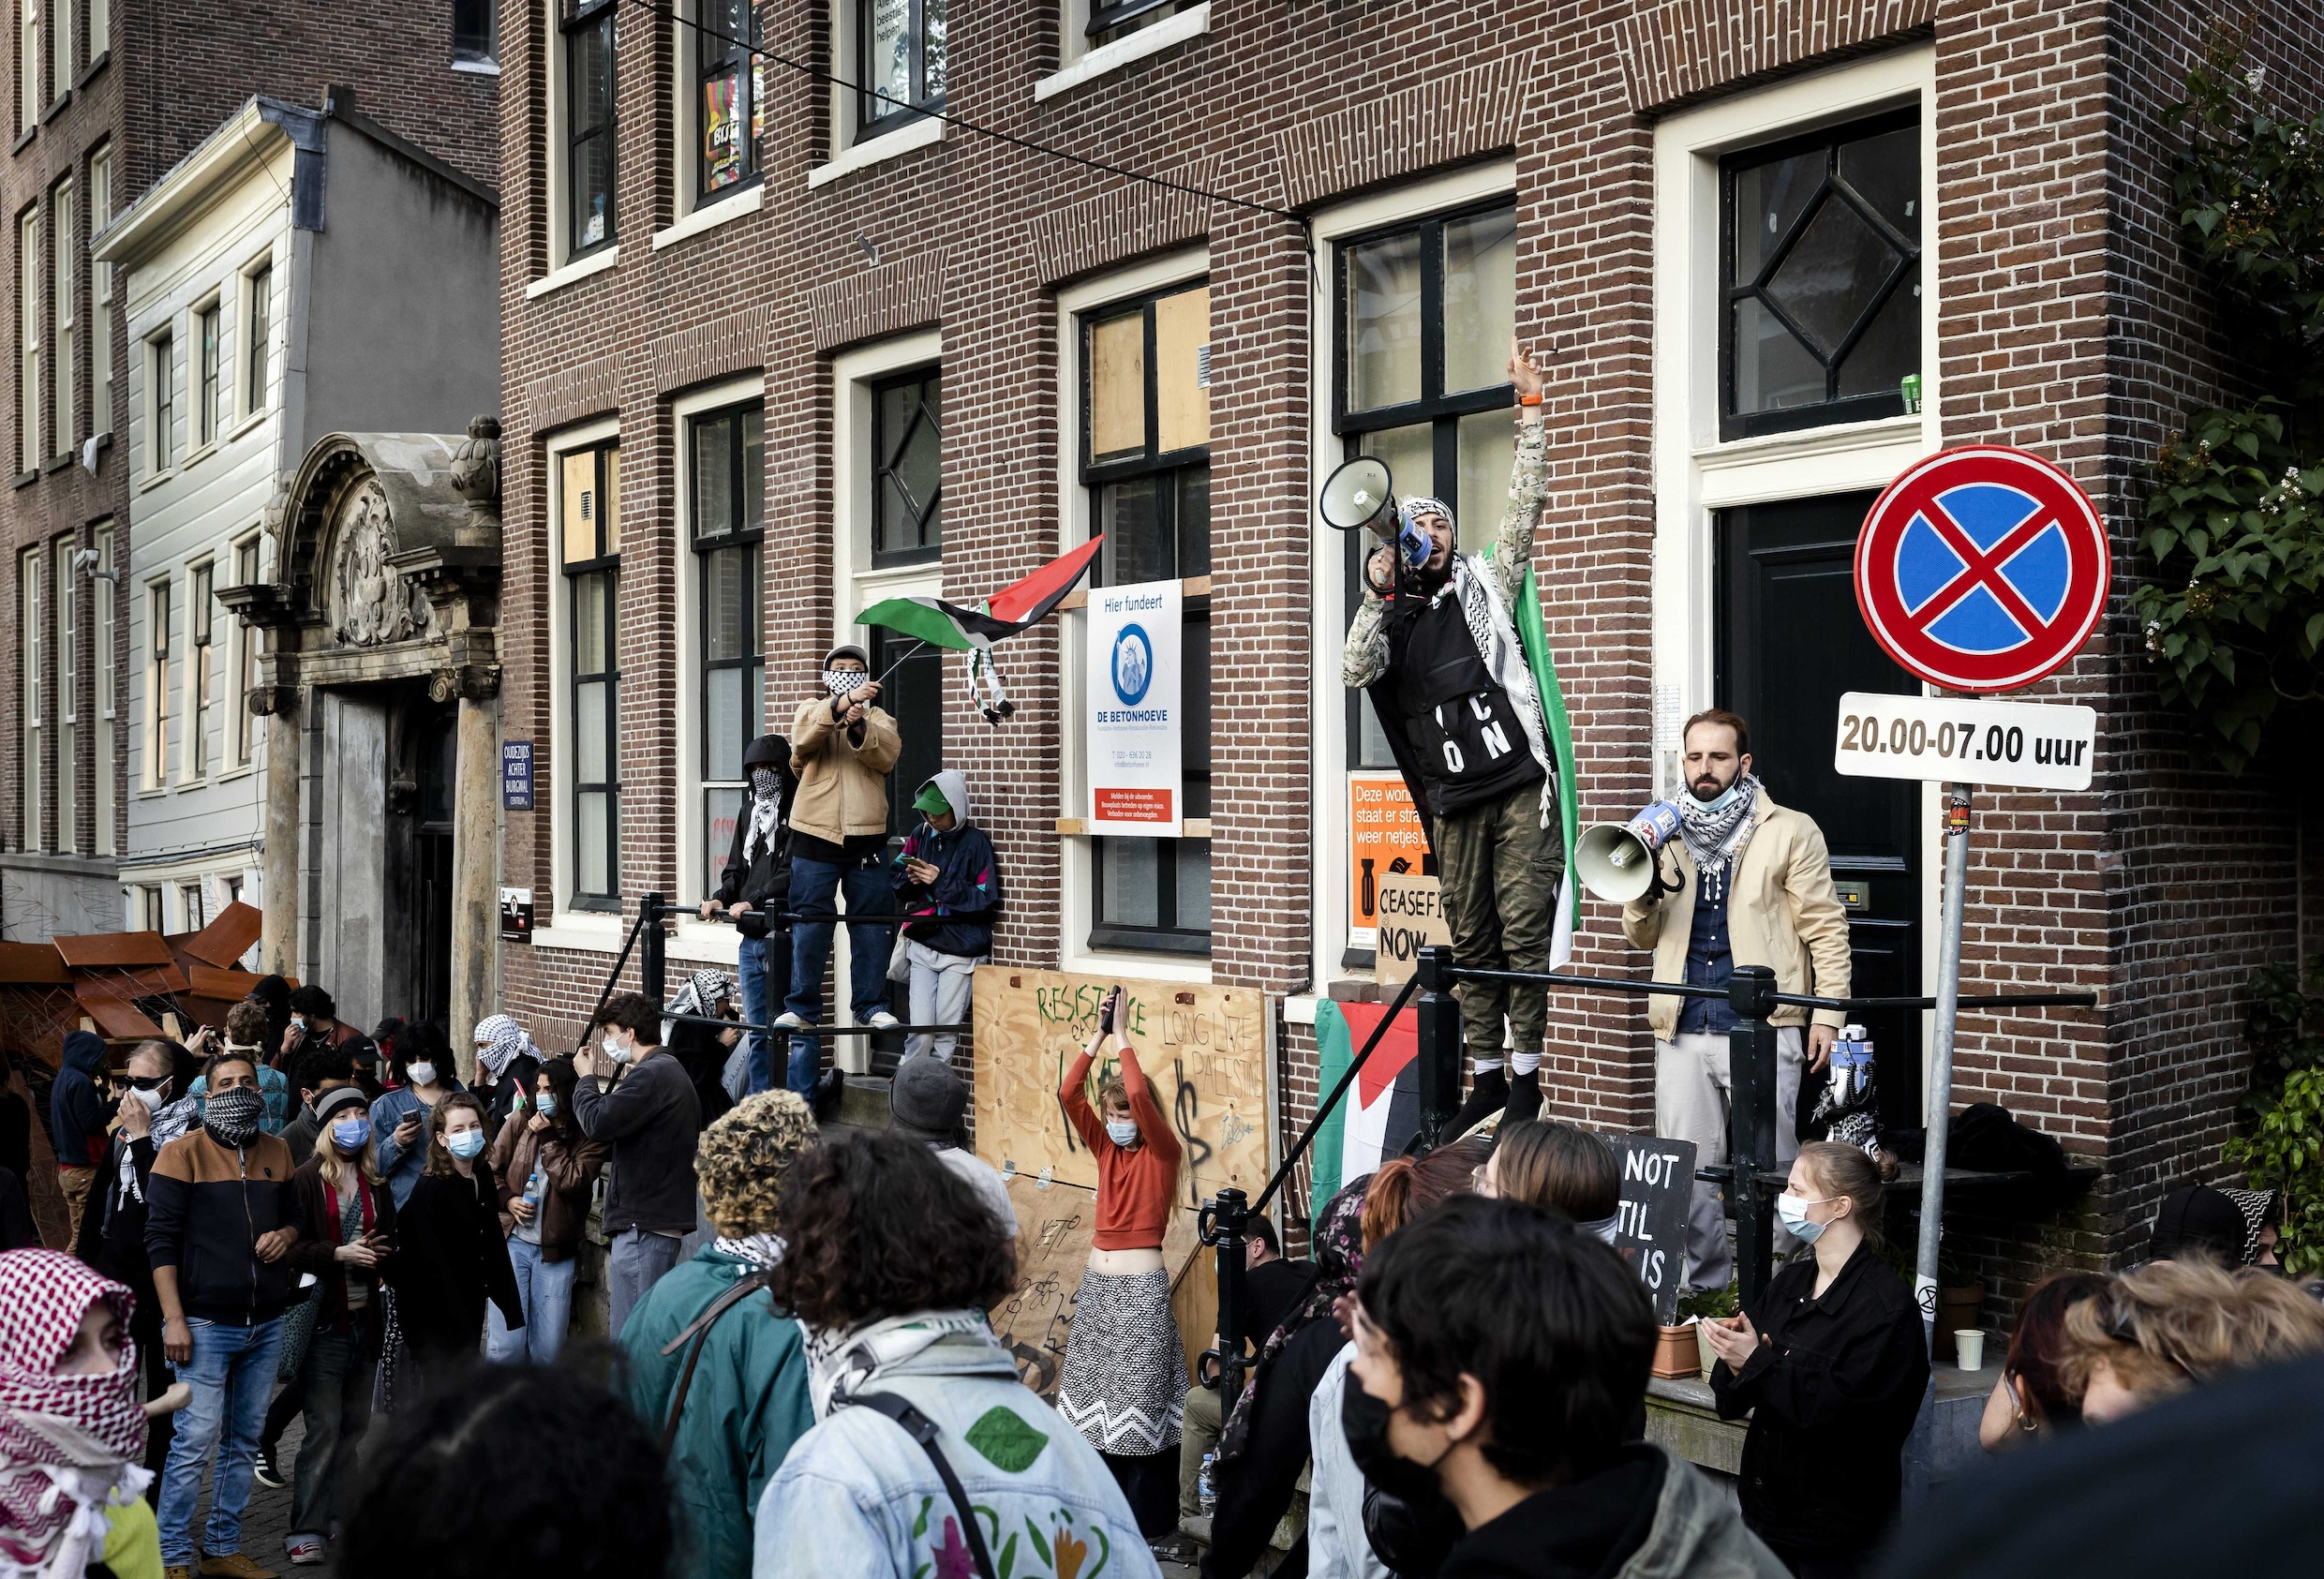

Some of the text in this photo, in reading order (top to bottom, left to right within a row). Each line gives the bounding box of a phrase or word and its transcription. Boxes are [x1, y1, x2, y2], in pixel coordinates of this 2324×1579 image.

[877, 25, 900, 43] helpen
[1105, 593, 1163, 613] Hier fundeert
[1097, 709, 1168, 723] DE BETONHOEVE
[1841, 715, 2088, 767] 20.00-07.00 uur
[508, 763, 527, 776] ACHTER
[1355, 785, 1414, 802] Deze woni
[1356, 809, 1421, 824] staat er stra
[1356, 830, 1383, 844] weer
[1385, 828, 1419, 849] netjes
[1379, 888, 1443, 918] CEASEFI
[1380, 927, 1427, 961] NOW
[1036, 983, 1147, 1037] RESISTCE
[1163, 1005, 1254, 1053] LONG LIVE
[1192, 1050, 1263, 1099] PALESTINE
[1624, 1149, 1680, 1190] NOT
[1618, 1199, 1654, 1242] TIL
[1641, 1248, 1665, 1289] IS
